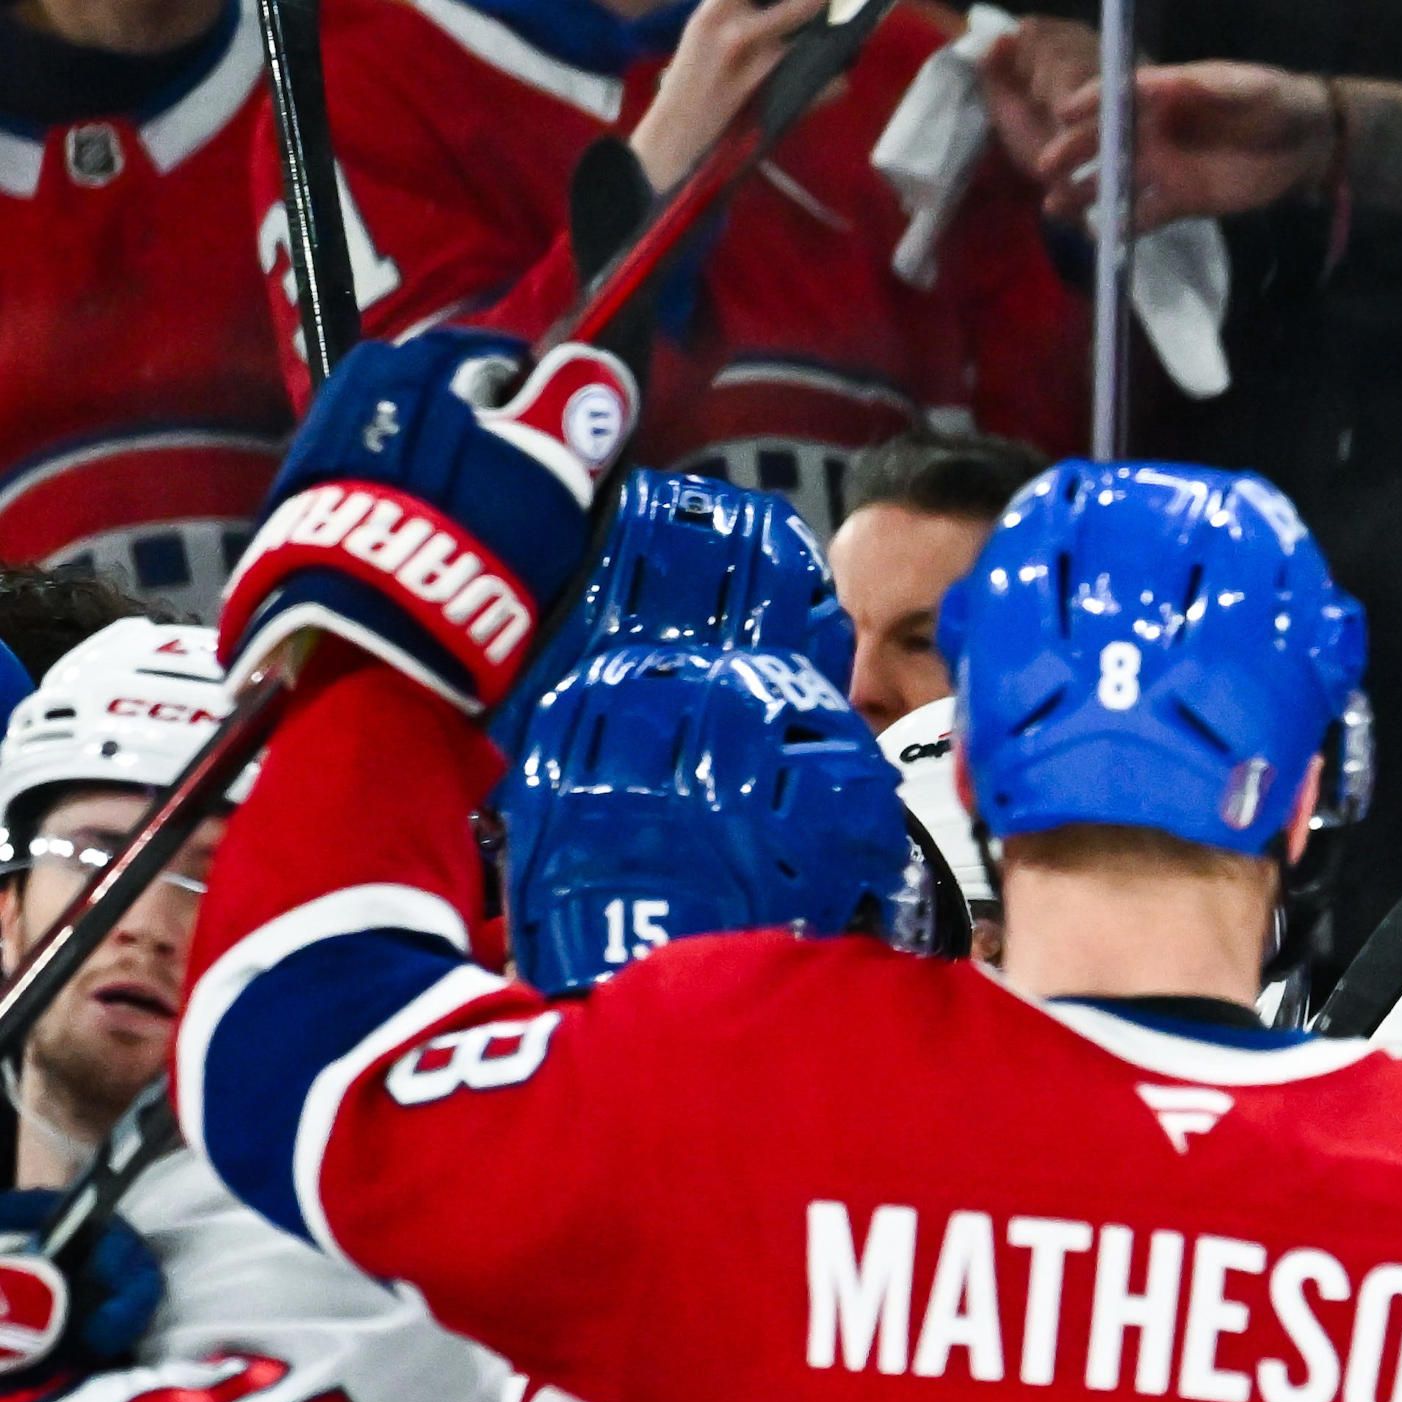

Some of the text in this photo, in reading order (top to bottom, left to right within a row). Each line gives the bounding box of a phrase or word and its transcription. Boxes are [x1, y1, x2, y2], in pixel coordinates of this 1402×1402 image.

[1098, 641, 1142, 710] 8
[604, 898, 670, 963] 15
[385, 1010, 562, 1108] 8
